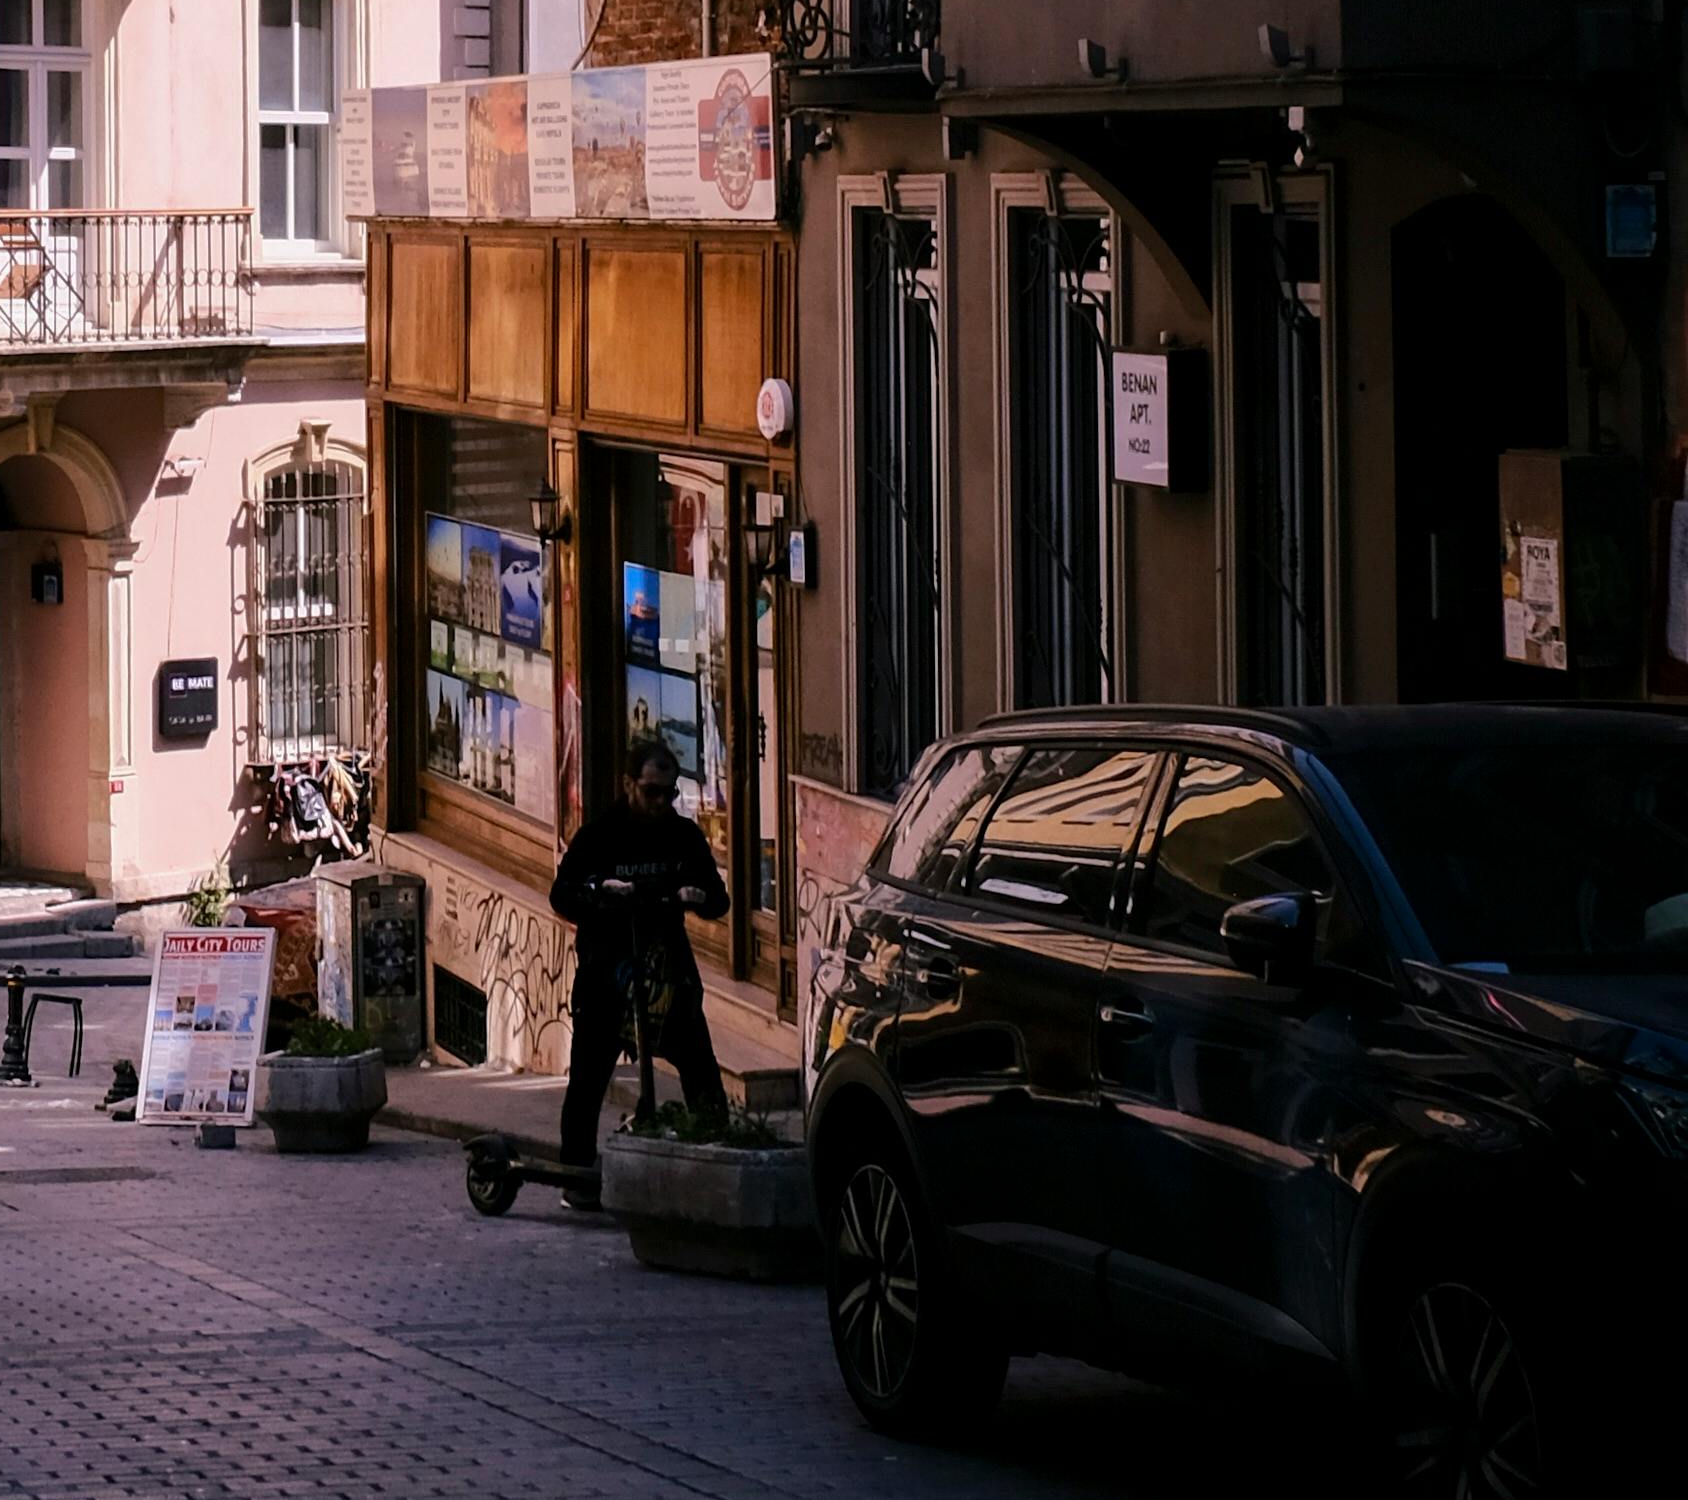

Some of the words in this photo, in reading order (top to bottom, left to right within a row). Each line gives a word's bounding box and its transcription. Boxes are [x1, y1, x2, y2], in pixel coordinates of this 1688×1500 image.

[1121, 372, 1158, 396] BENAN
[1129, 403, 1153, 425] APT.
[172, 678, 185, 691] BE
[187, 676, 214, 690] MATE
[196, 935, 224, 953] CITY
[225, 935, 266, 953] TOURS
